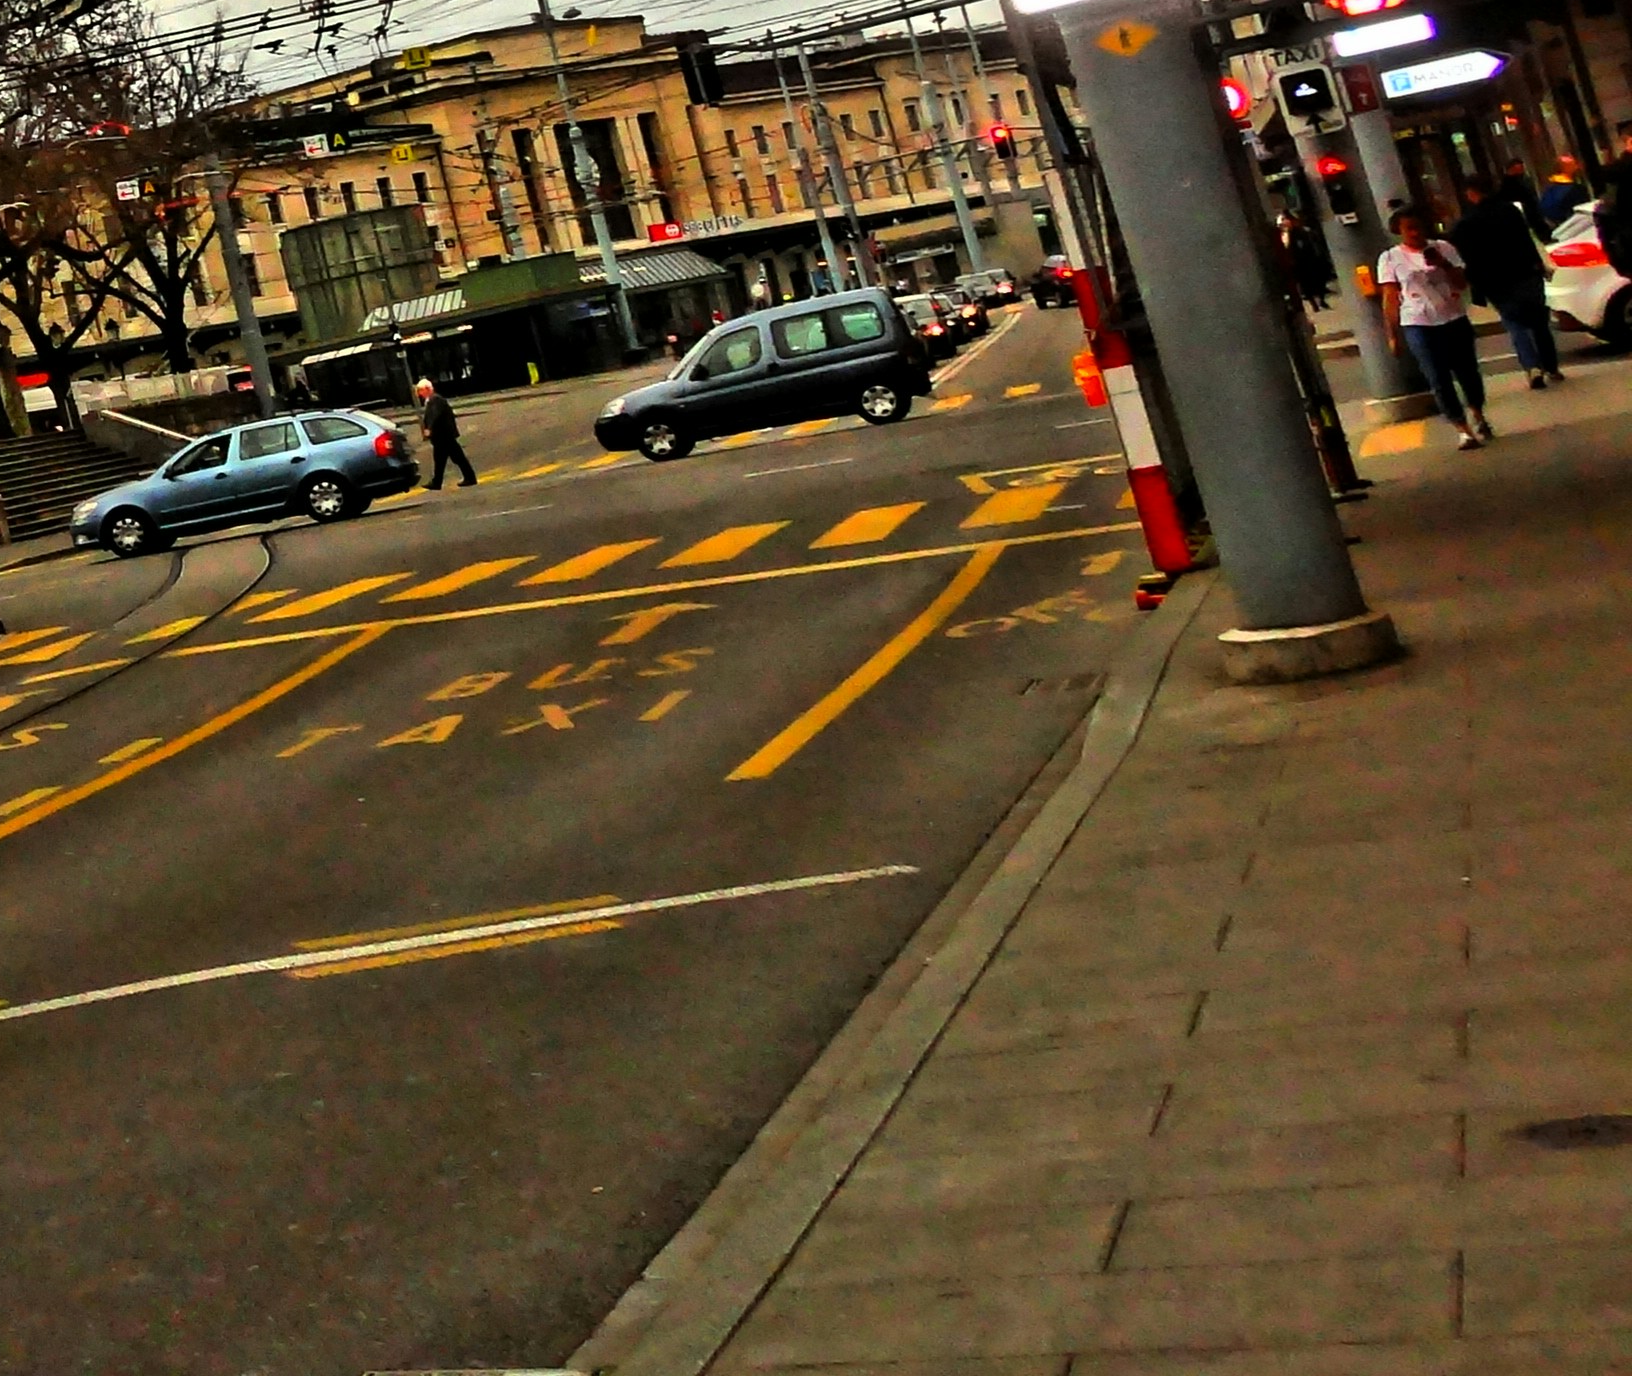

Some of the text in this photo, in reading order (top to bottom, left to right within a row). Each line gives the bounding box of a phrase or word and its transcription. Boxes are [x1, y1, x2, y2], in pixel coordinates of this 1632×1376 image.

[1270, 43, 1319, 68] TAXI
[333, 133, 346, 147] A
[426, 646, 715, 702] BUS
[276, 689, 693, 758] TAXI
